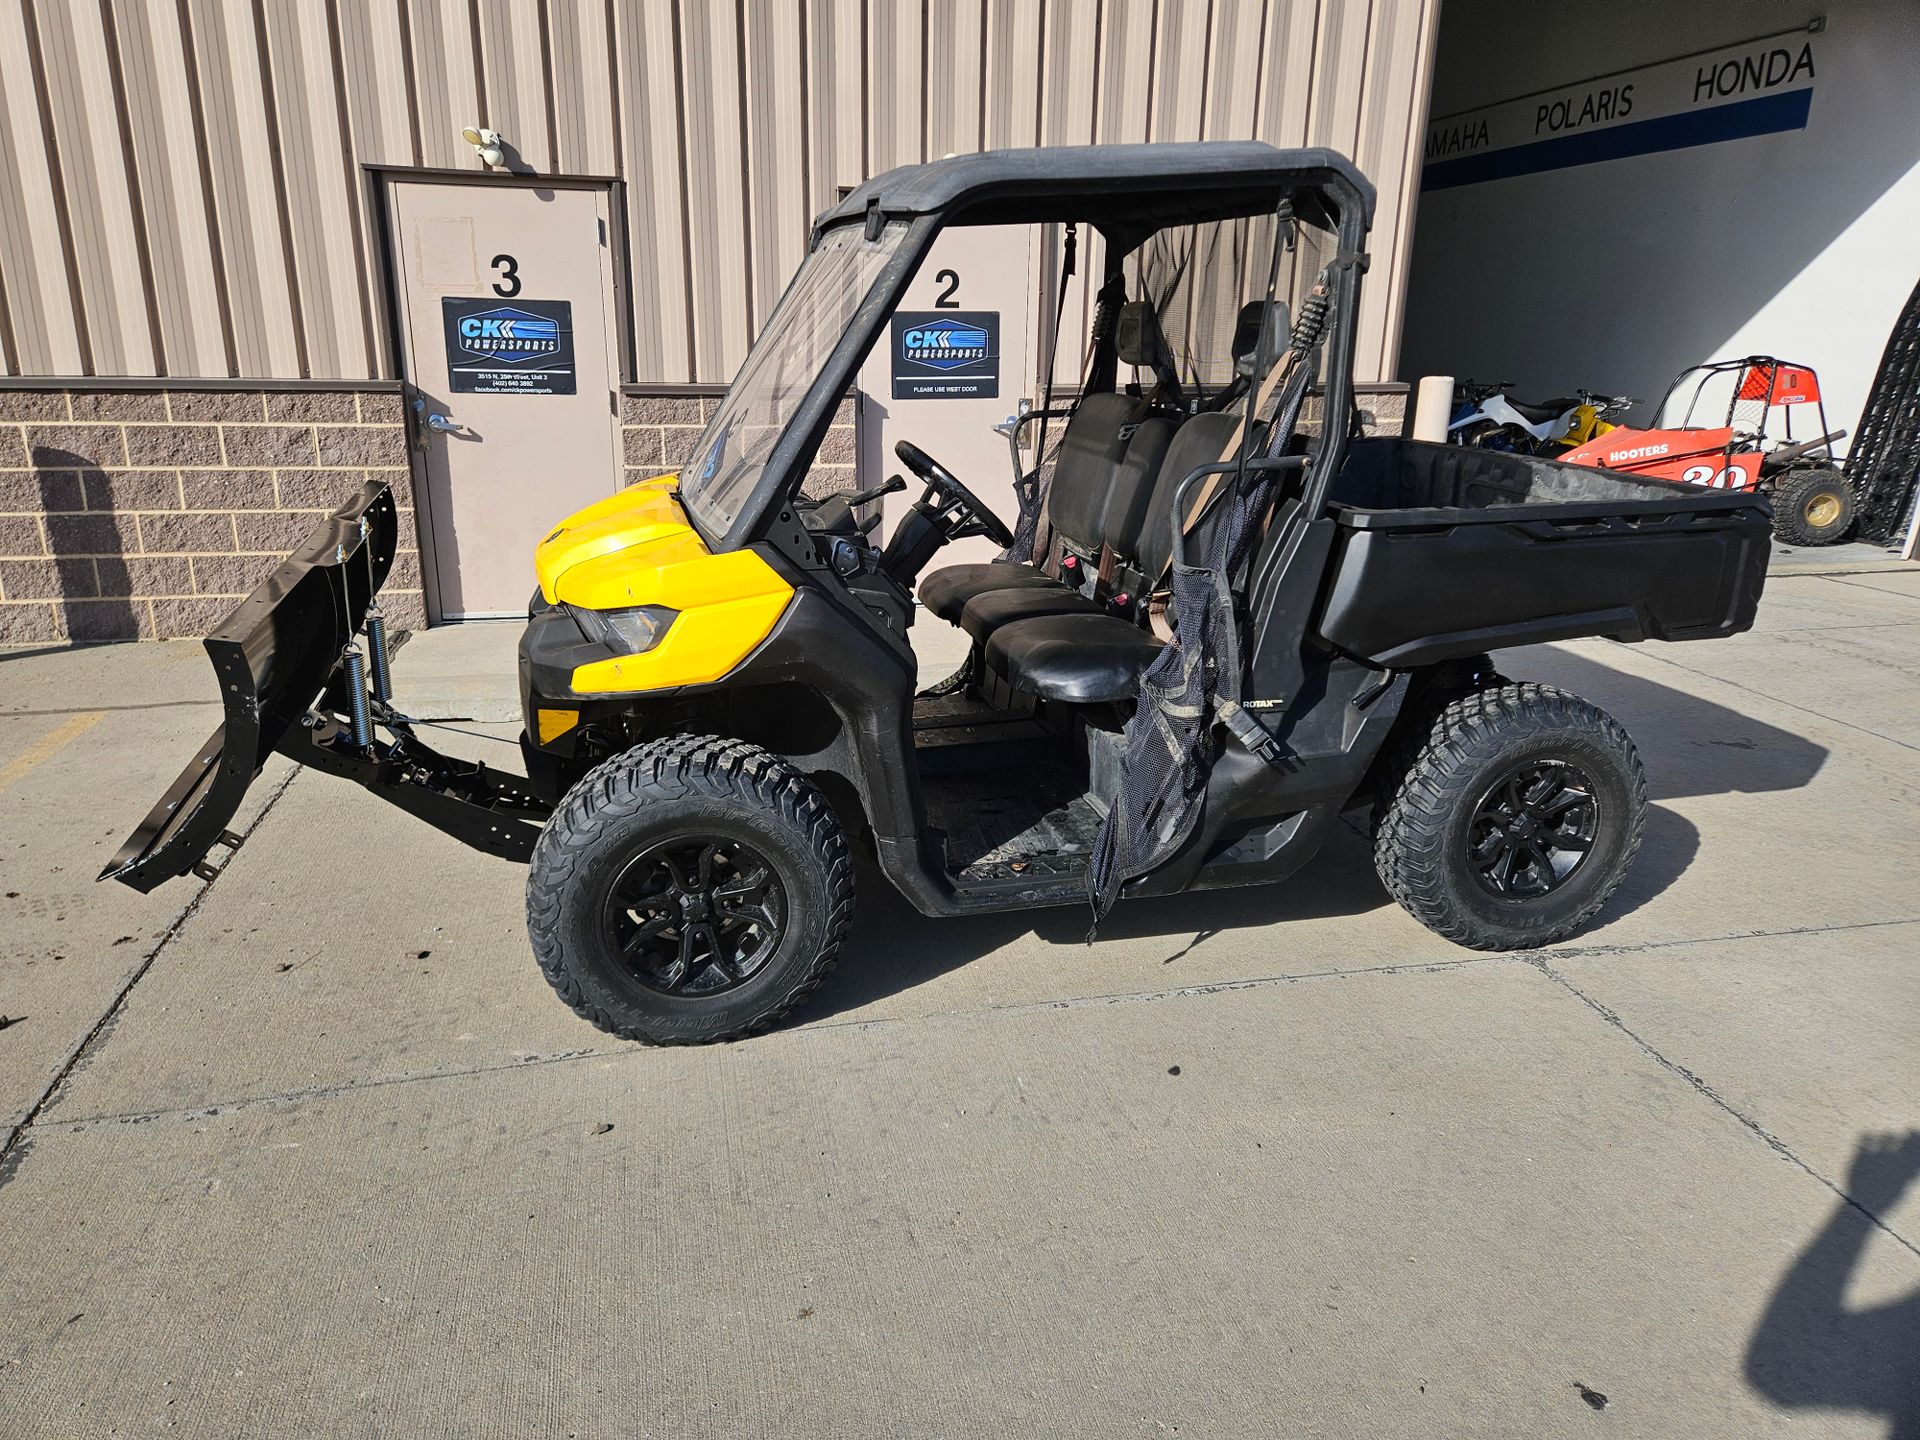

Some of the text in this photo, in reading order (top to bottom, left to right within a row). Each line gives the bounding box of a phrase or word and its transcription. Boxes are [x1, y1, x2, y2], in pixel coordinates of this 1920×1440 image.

[1535, 84, 1634, 135] POLARIS
[1694, 42, 1815, 102] HONDA
[491, 254, 521, 298] 3
[935, 269, 960, 308] 2
[465, 339, 554, 351] POWERSPORTS
[908, 348, 984, 359] POWERSPORTS
[1609, 444, 1669, 462] HOOTERS
[1242, 699, 1274, 708] ROTAX
